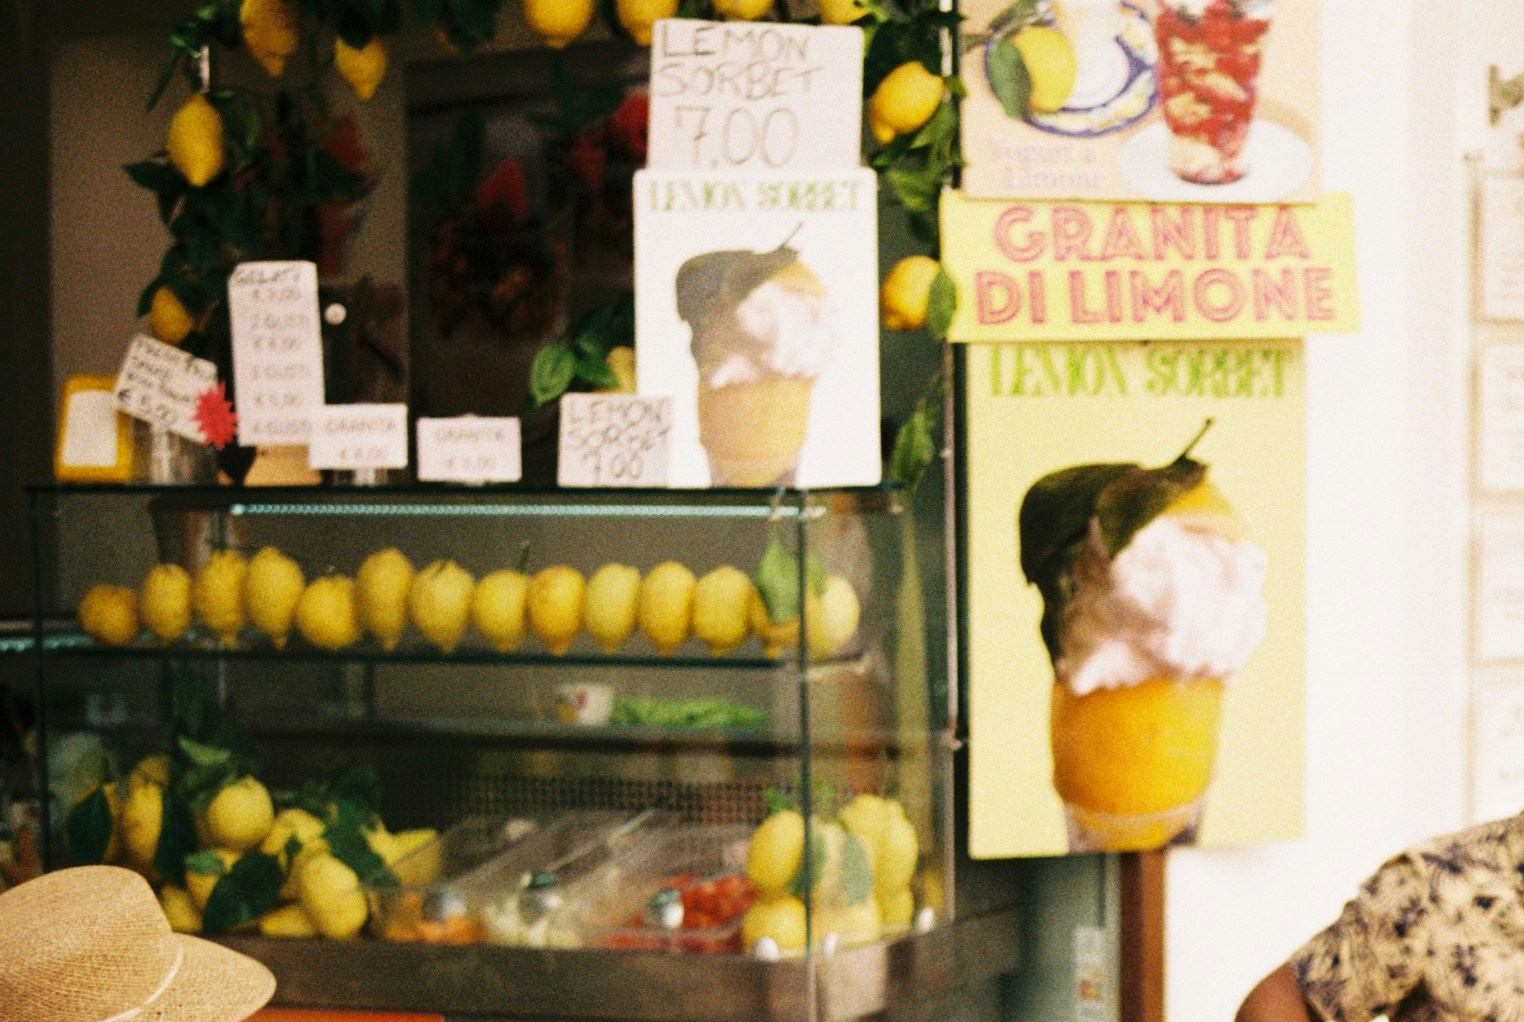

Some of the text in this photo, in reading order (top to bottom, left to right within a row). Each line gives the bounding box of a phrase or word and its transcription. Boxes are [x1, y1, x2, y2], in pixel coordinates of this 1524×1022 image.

[660, 23, 809, 62] LEMON
[653, 61, 826, 100] SORBET
[649, 179, 860, 212] LEMON SORBET
[993, 205, 1311, 262] GRANITA
[975, 265, 1336, 327] DI LIMONE
[989, 346, 1293, 399] LEMON SORBET
